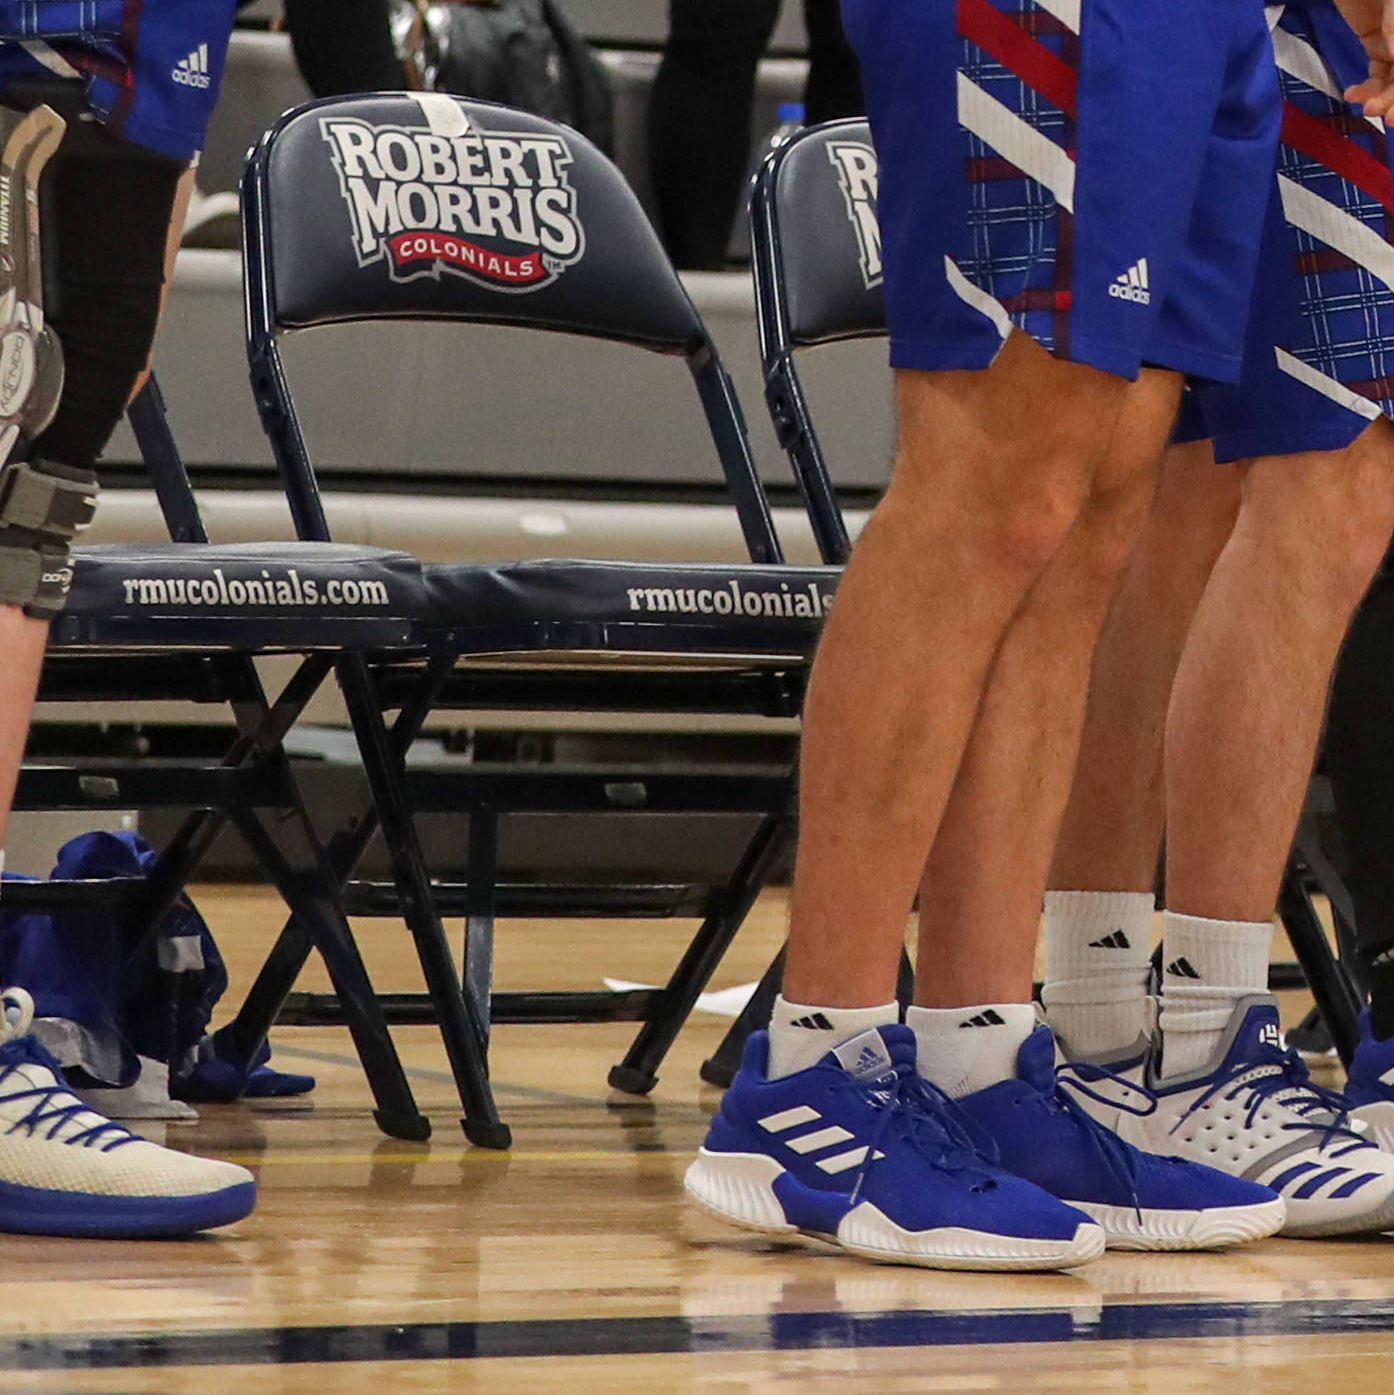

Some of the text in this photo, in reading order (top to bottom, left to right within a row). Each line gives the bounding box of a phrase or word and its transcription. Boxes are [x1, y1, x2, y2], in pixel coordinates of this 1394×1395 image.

[171, 69, 210, 89] adidas
[329, 123, 562, 188] ROBERT
[347, 177, 577, 255] MORRIS
[399, 238, 535, 277] COLONIALS
[1108, 283, 1150, 306] adidas
[122, 569, 390, 605] rmucolonials.com
